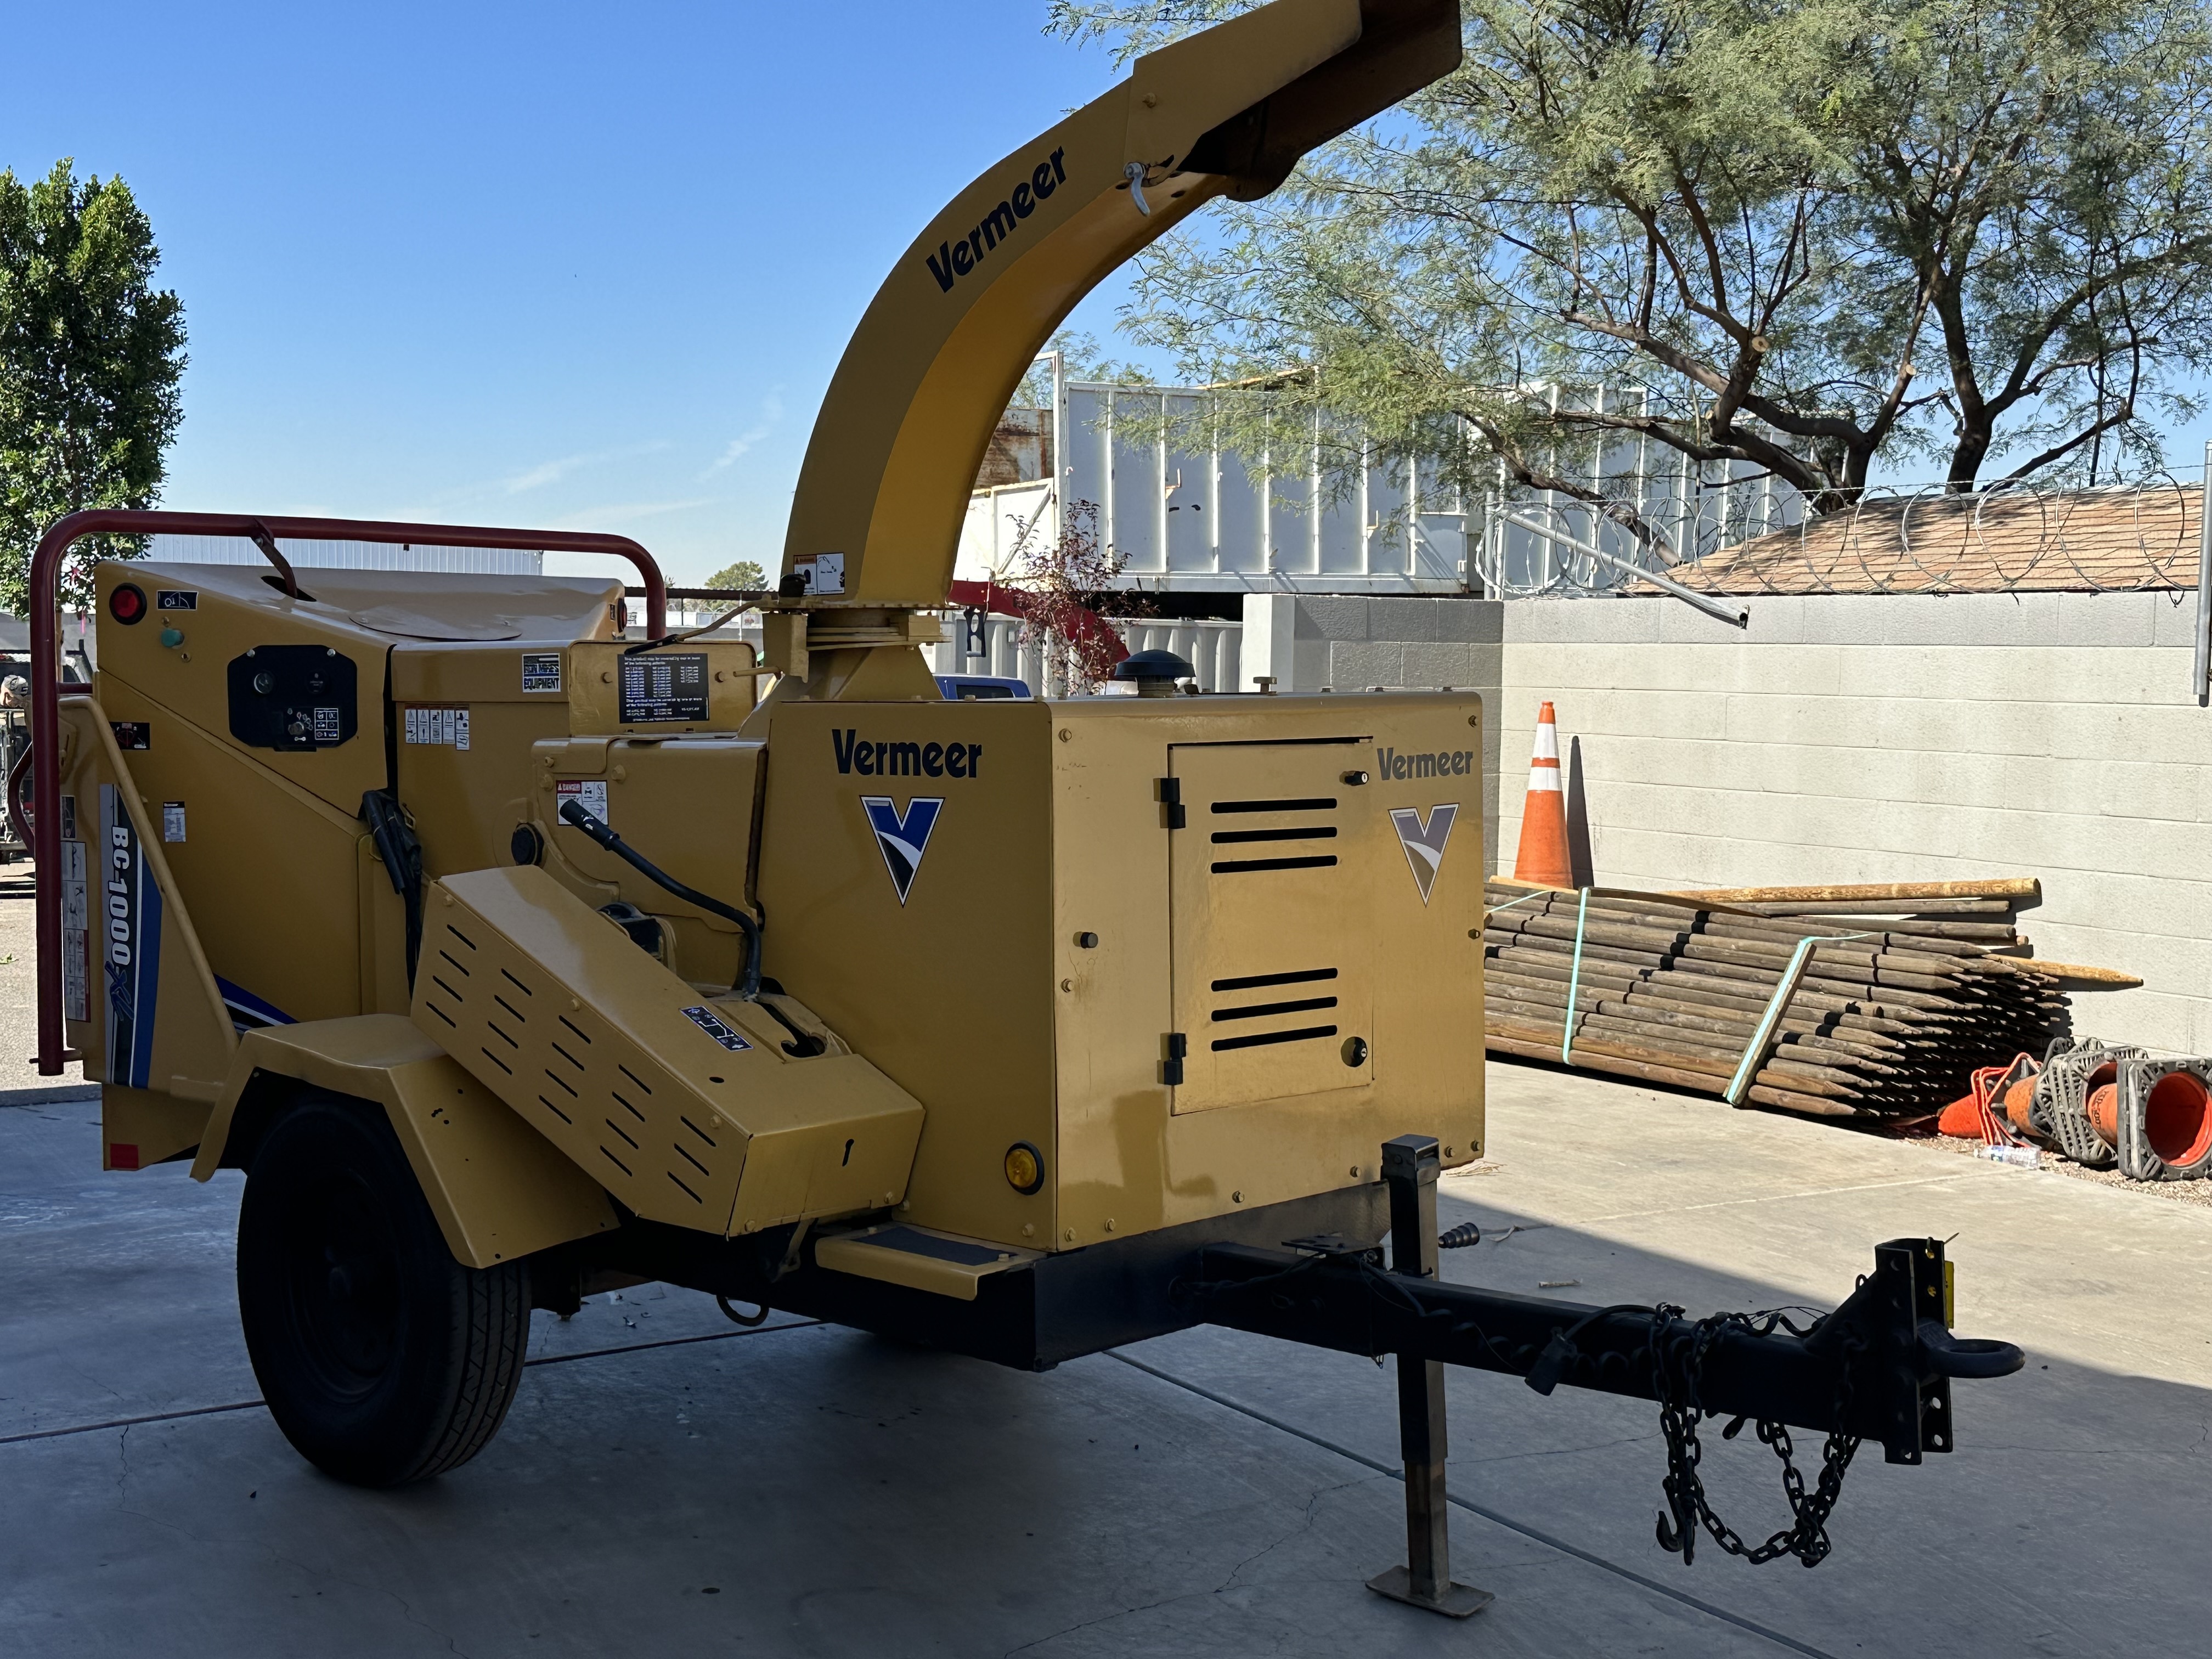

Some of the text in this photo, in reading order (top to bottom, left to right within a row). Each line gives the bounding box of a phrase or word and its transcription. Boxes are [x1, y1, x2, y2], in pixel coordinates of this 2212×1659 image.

[926, 145, 1066, 294] Vermeer
[832, 729, 982, 778] Vermeer
[1377, 747, 1473, 780] Vermeer
